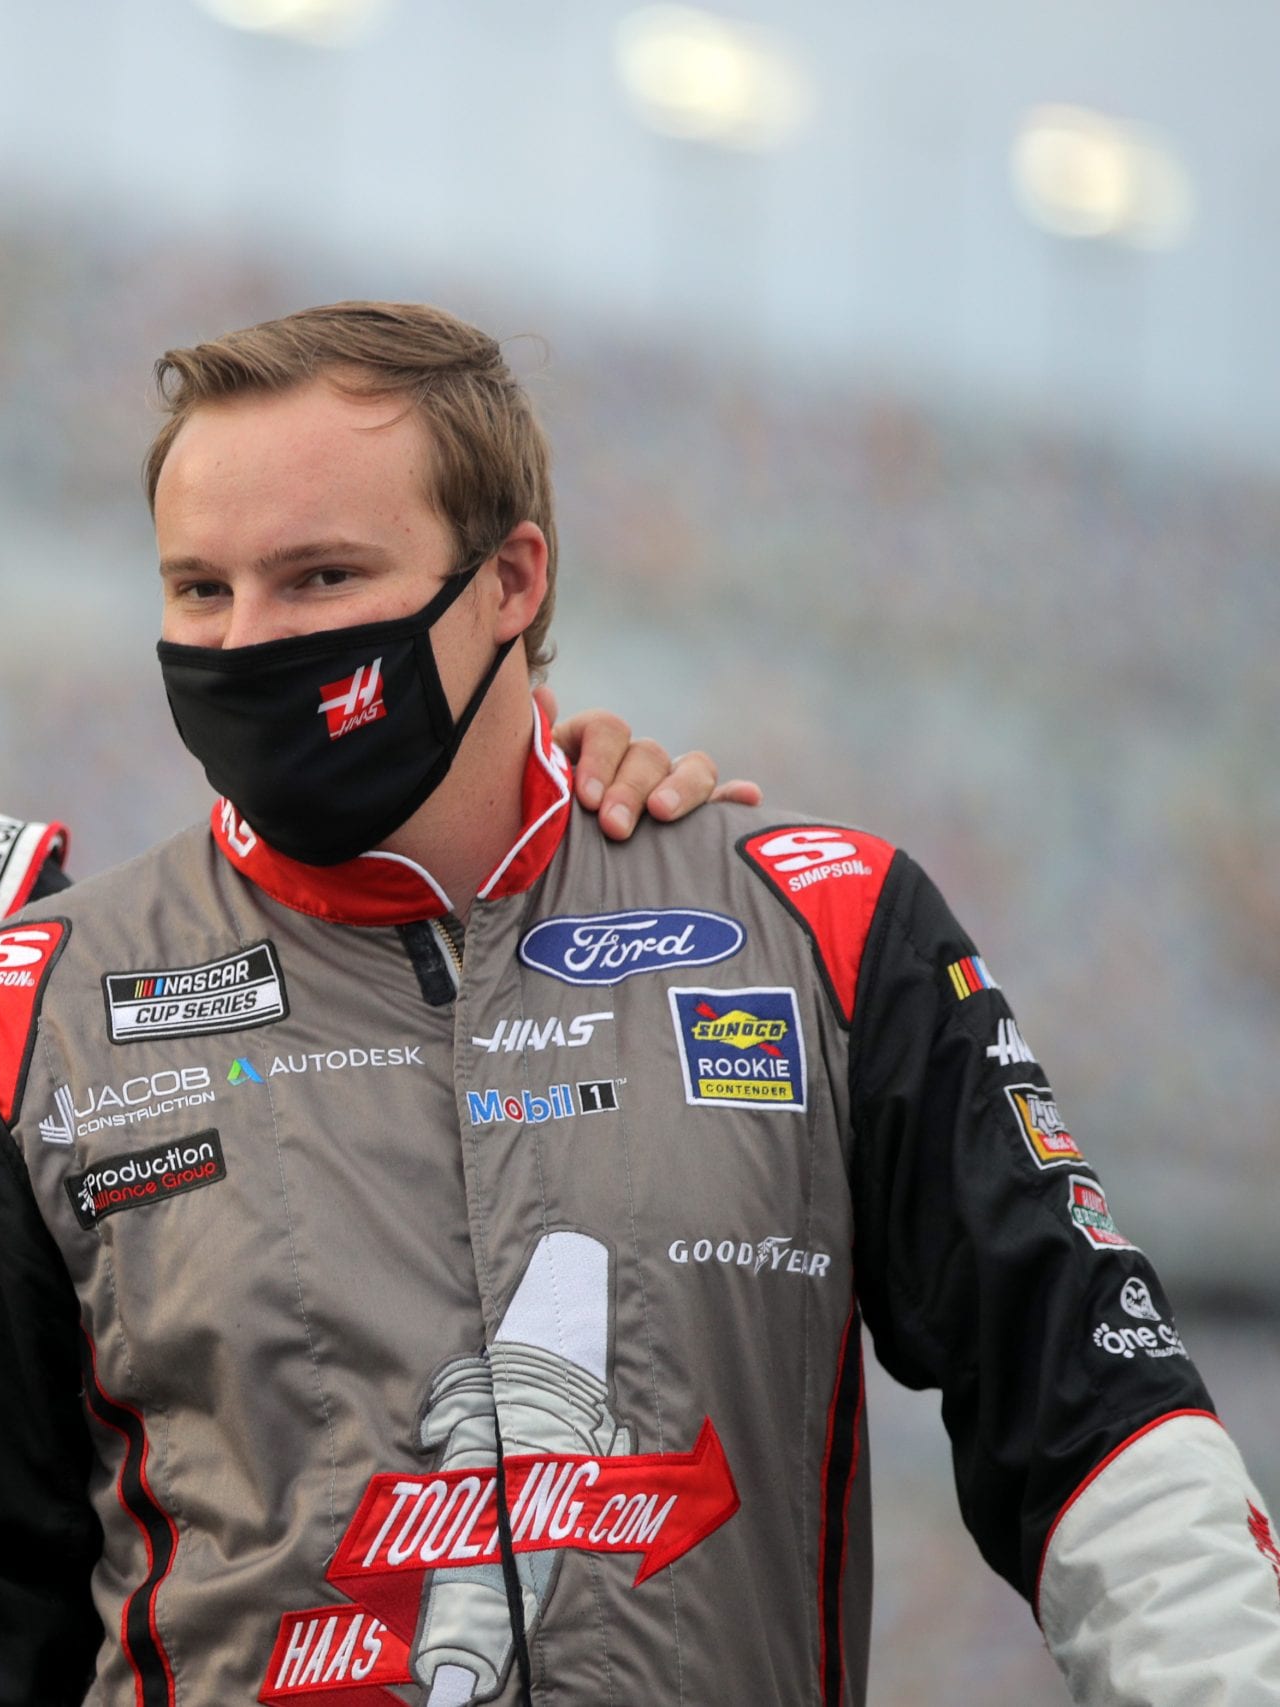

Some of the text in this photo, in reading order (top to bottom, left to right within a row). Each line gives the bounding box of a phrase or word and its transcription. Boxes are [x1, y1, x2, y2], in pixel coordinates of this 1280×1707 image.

[330, 699, 384, 738] HAAS
[788, 860, 865, 892] SIMPSON
[565, 919, 695, 972] Ford
[163, 960, 250, 995] NASCAR
[135, 990, 258, 1024] CUP SERIES
[472, 1012, 614, 1053] HAAS
[697, 1022, 783, 1038] SUNOCO
[269, 1046, 425, 1077] AUTODESK
[698, 1058, 791, 1078] ROOKIE
[74, 1067, 211, 1117] JACOB
[467, 1084, 575, 1125] Mobil
[706, 1083, 787, 1096] CONTENDER
[77, 1091, 216, 1137] CONSTRUCTION
[86, 1143, 214, 1195] Production
[161, 1162, 217, 1191] Group
[668, 1236, 831, 1277] GOODYEAR
[275, 1613, 387, 1690] HAAS
